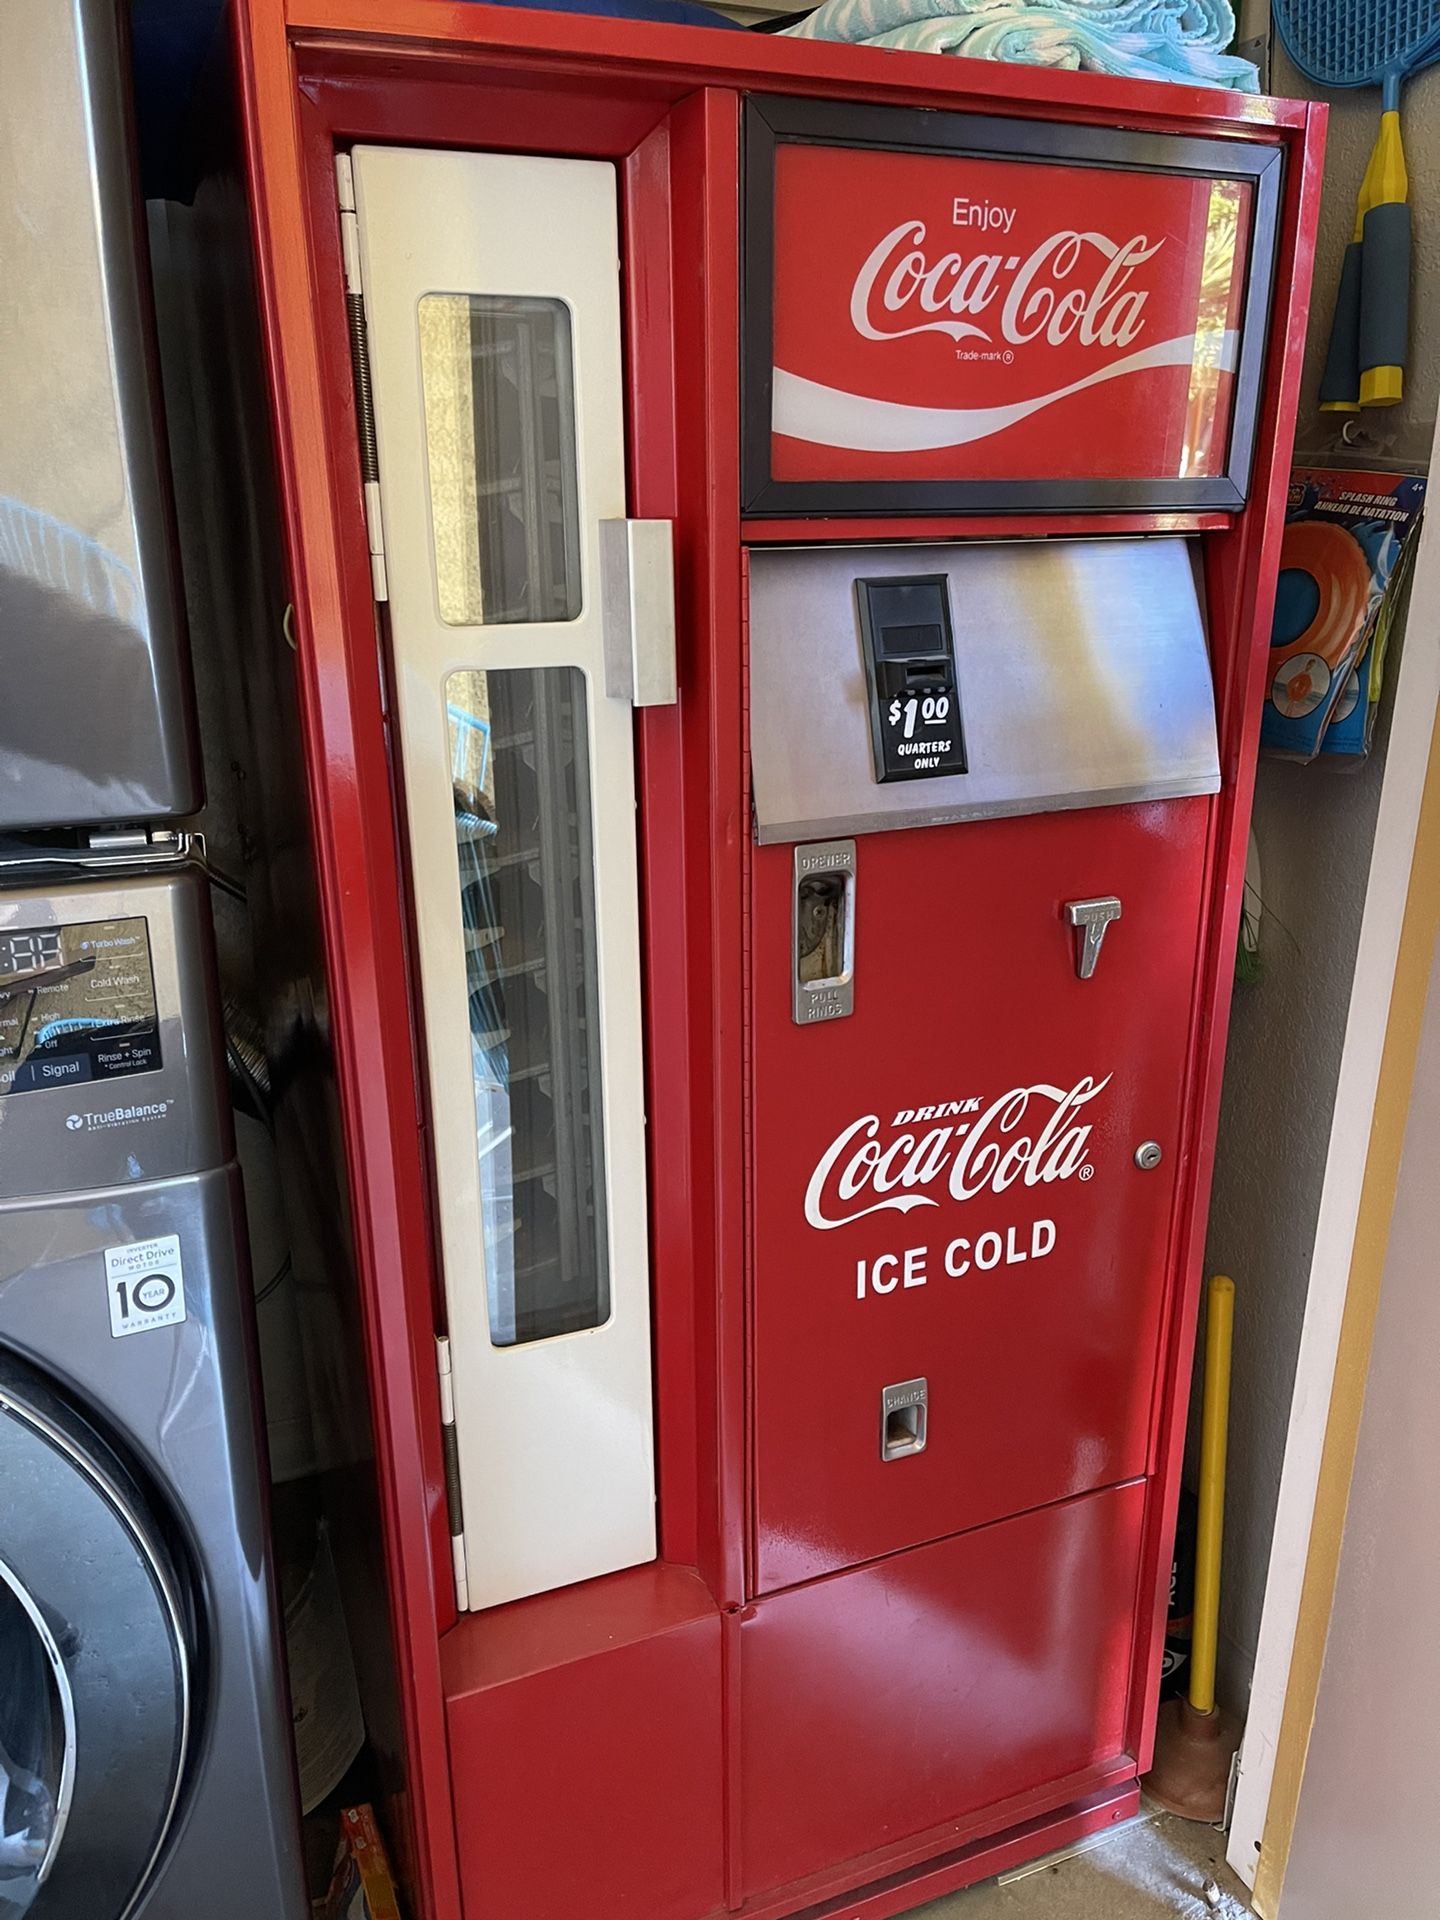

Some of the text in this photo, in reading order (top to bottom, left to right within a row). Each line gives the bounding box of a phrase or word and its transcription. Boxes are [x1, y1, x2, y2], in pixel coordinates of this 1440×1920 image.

[953, 198, 1016, 233] Enjoy
[850, 220, 1167, 347] Coca-Cola
[1339, 491, 1398, 507] SPLASH RING
[1314, 501, 1409, 522] ANNEAU DE NATATION
[898, 740, 952, 756] QUARTERS
[914, 757, 940, 769] ONLY
[801, 853, 850, 869] OPENER
[1084, 911, 1115, 922] PUSH
[37, 984, 69, 994] Remote
[91, 975, 140, 989] Cold Wash
[811, 992, 839, 1004] PULL
[41, 1013, 60, 1023] High
[808, 1004, 842, 1019] RINGS
[0, 1017, 18, 1028] rmal
[45, 1040, 58, 1049] Off
[98, 1053, 122, 1063] Rinse
[131, 1048, 152, 1060] Spin
[132, 1058, 147, 1068] Lock
[42, 1061, 80, 1077] Signal
[890, 1096, 984, 1127] DRINK
[127, 1243, 158, 1253] INVERTER
[111, 1247, 174, 1267] Direct Drive
[856, 1219, 1056, 1300] ICE COLD
[128, 1260, 160, 1270] MOTOR
[116, 1273, 175, 1319] 10
[142, 1288, 165, 1299] YEAR
[122, 1312, 176, 1329] WARRANTY
[887, 1389, 926, 1408] CHANGE
